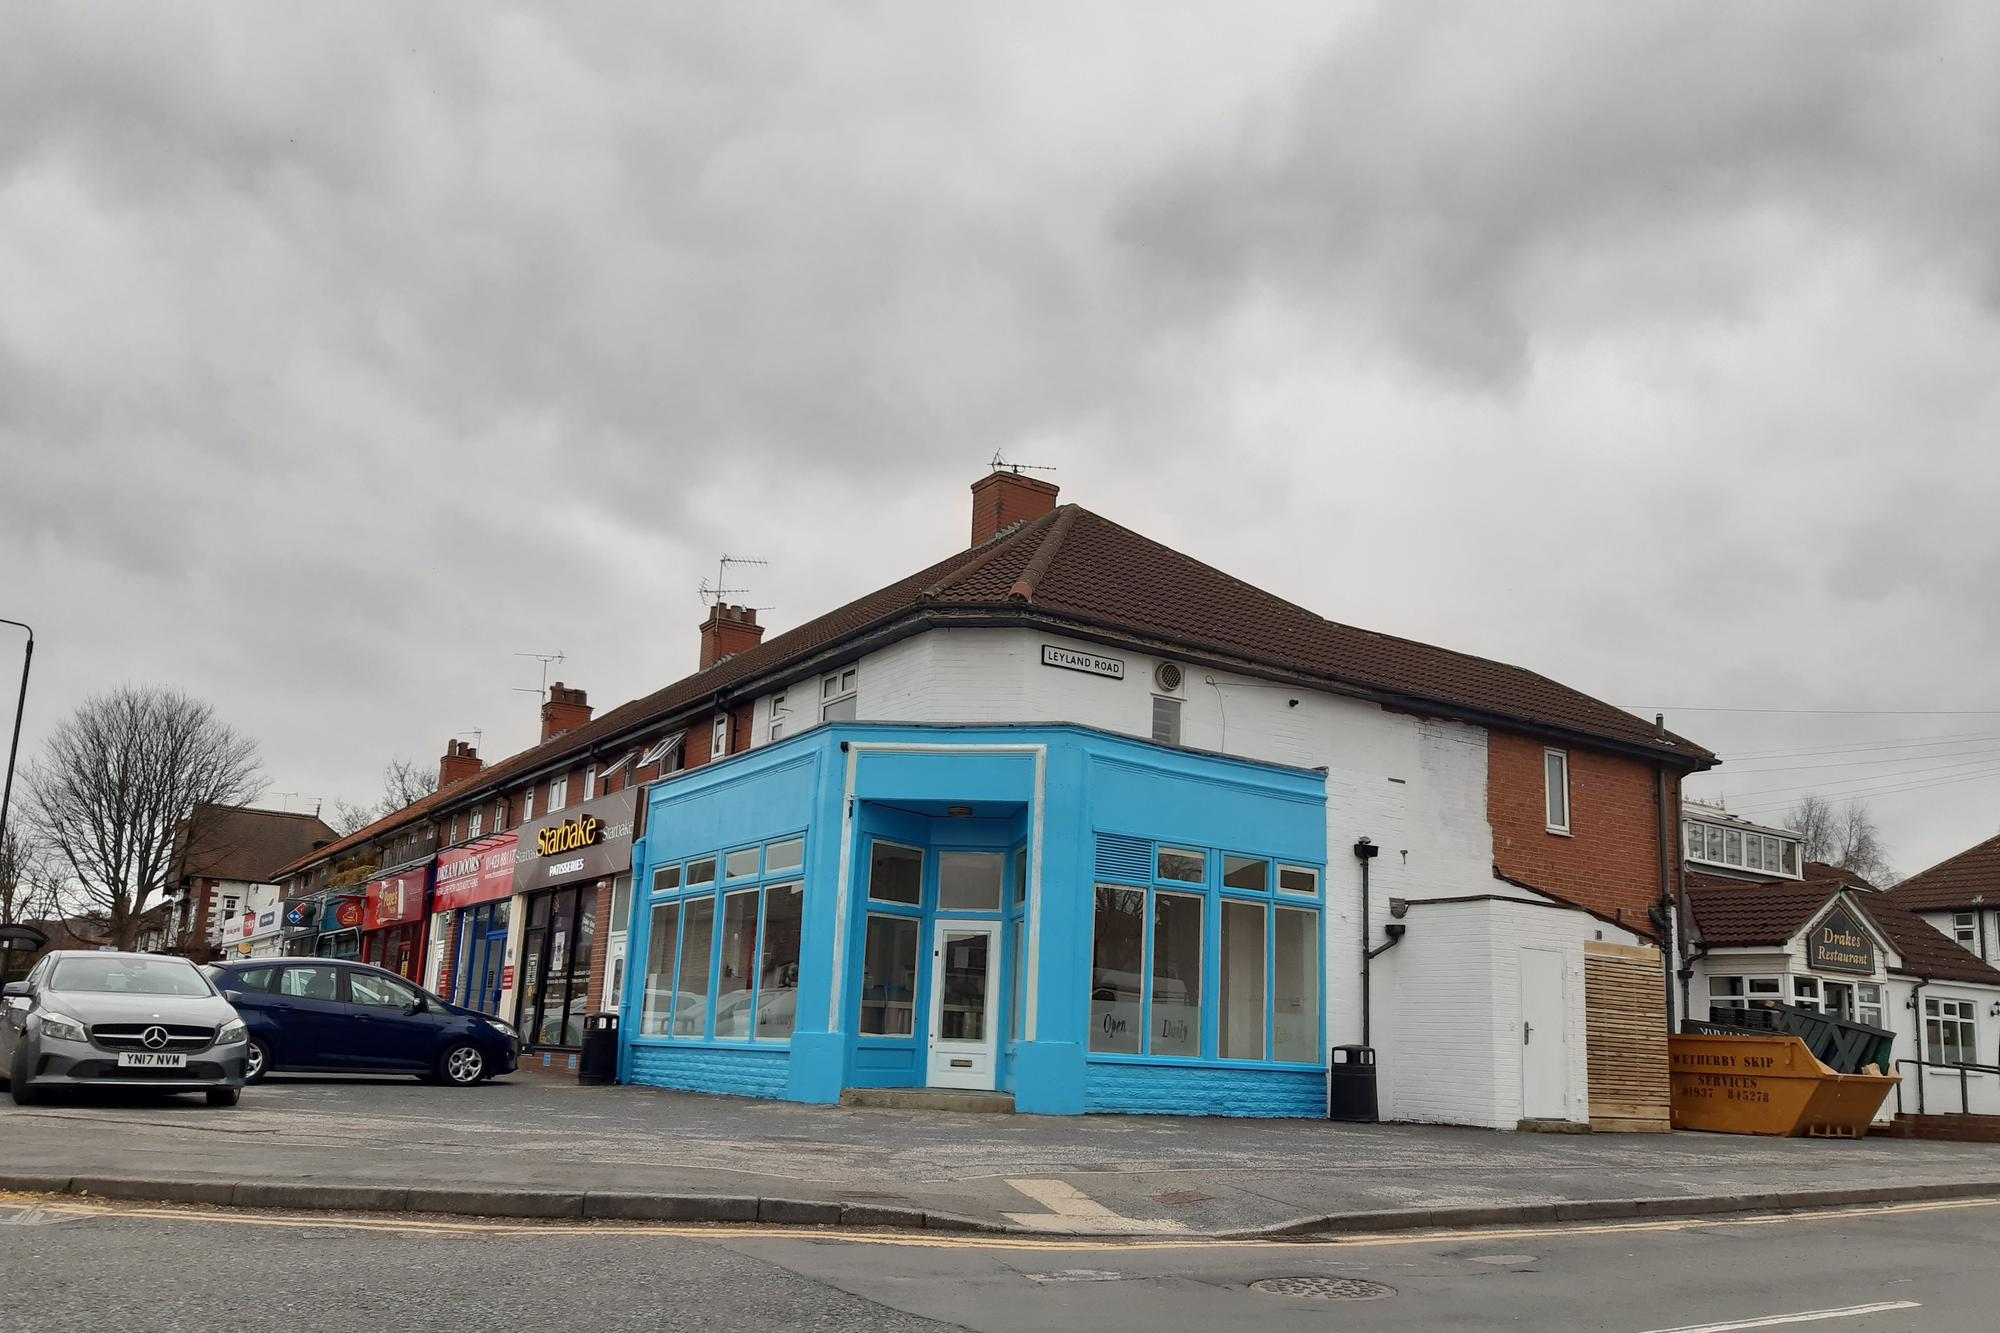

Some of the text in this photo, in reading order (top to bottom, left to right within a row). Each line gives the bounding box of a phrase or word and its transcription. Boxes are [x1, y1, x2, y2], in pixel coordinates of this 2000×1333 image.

[1048, 650, 1120, 673] LEYLAND ROAD
[536, 813, 597, 857] Starbake
[602, 820, 634, 841] Starbake
[549, 858, 585, 877] PATISSERIES
[1823, 927, 1861, 948] Drakes
[1817, 945, 1867, 965] Restaurant
[1103, 1013, 1188, 1043] Open Daily
[127, 1053, 180, 1066] YN17 NVM
[1672, 1053, 1774, 1068] WETHERBY SKIP
[1698, 1075, 1757, 1089] SERVICES
[1681, 1087, 1713, 1098] 01937
